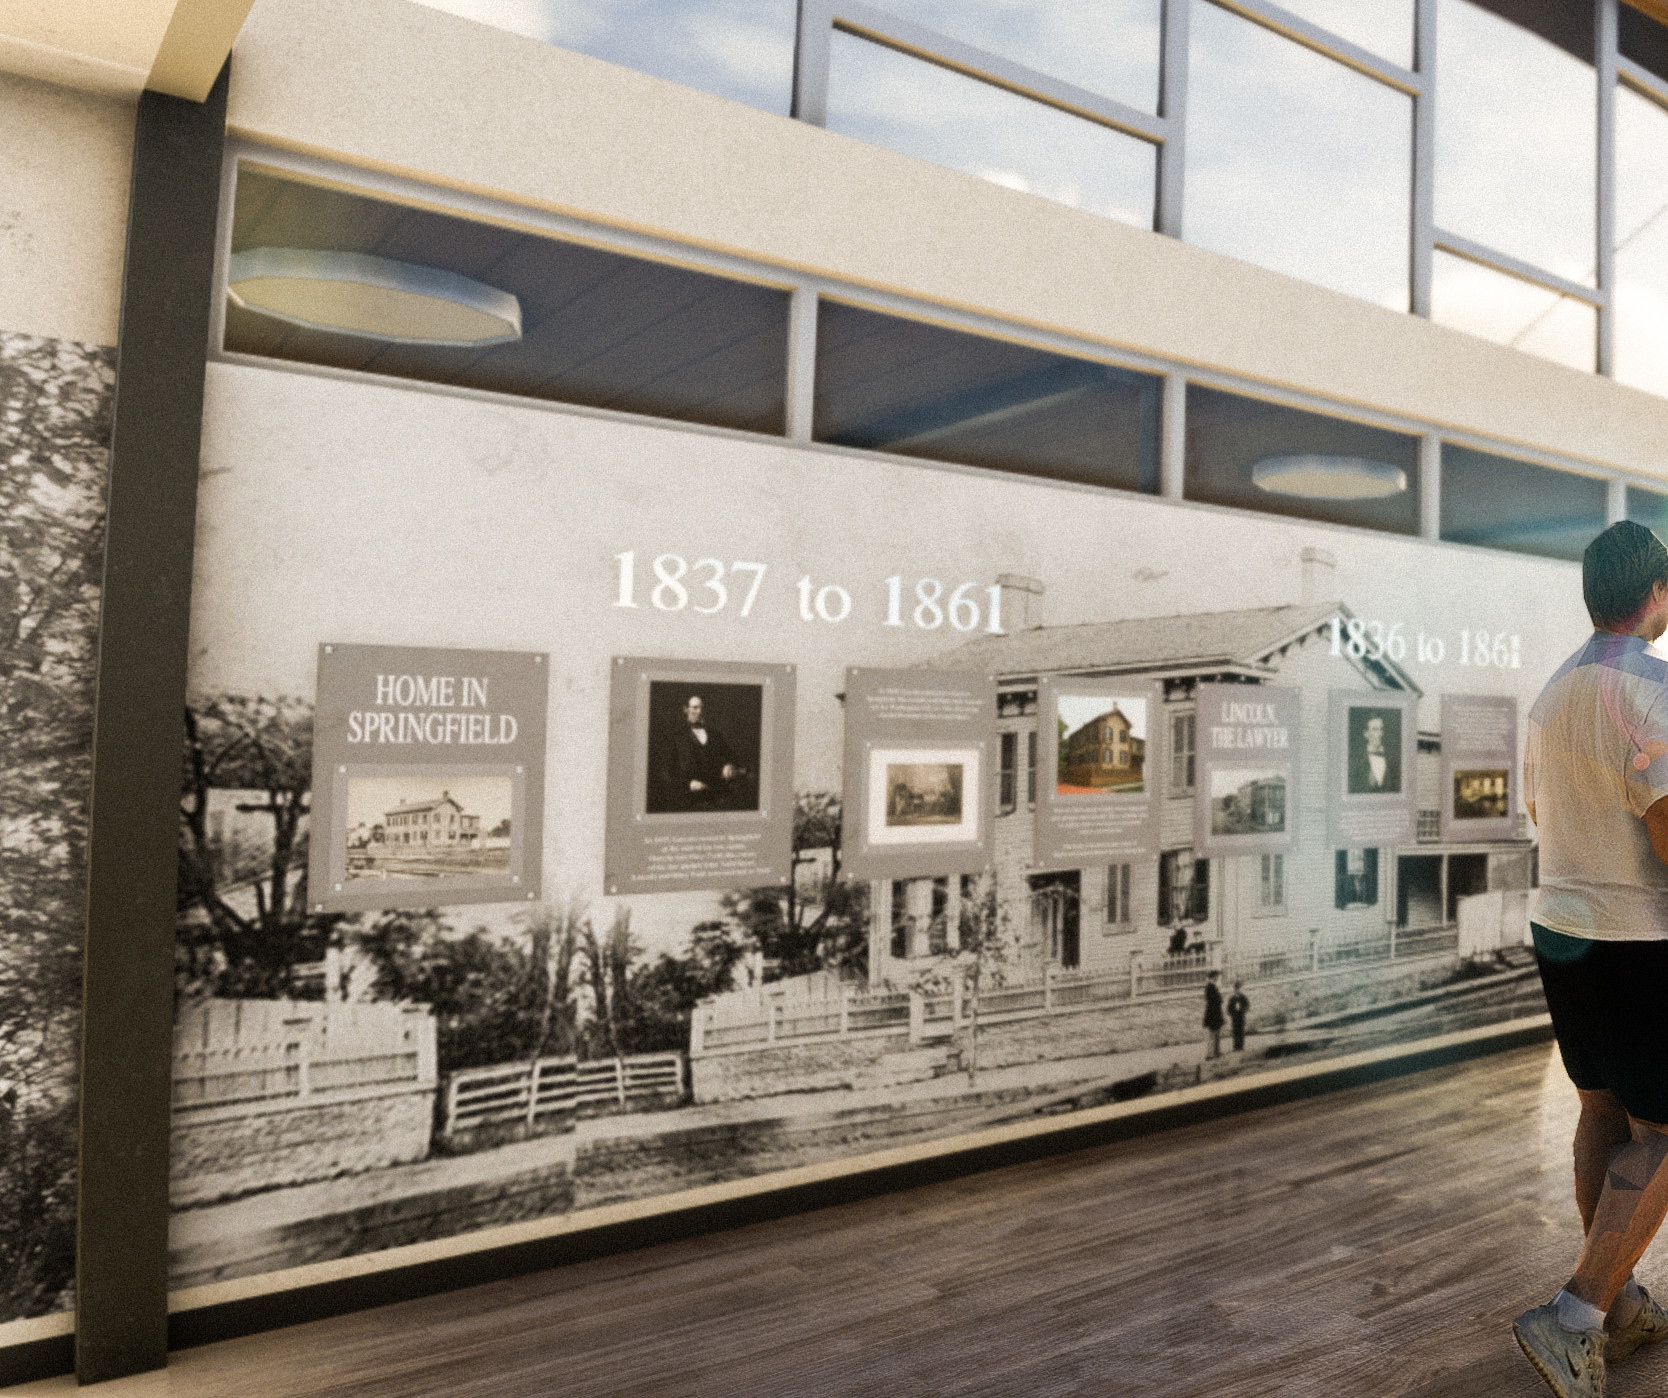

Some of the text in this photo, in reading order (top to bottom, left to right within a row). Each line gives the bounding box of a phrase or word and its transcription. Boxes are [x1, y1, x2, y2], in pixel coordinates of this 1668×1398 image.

[612, 549, 1007, 635] 1837 to 1861
[1329, 617, 1521, 670] 1836 to 1861
[375, 674, 489, 708] HOME IN
[346, 710, 519, 745] SPRINGFIELD
[1210, 726, 1290, 749] THE LAWYER
